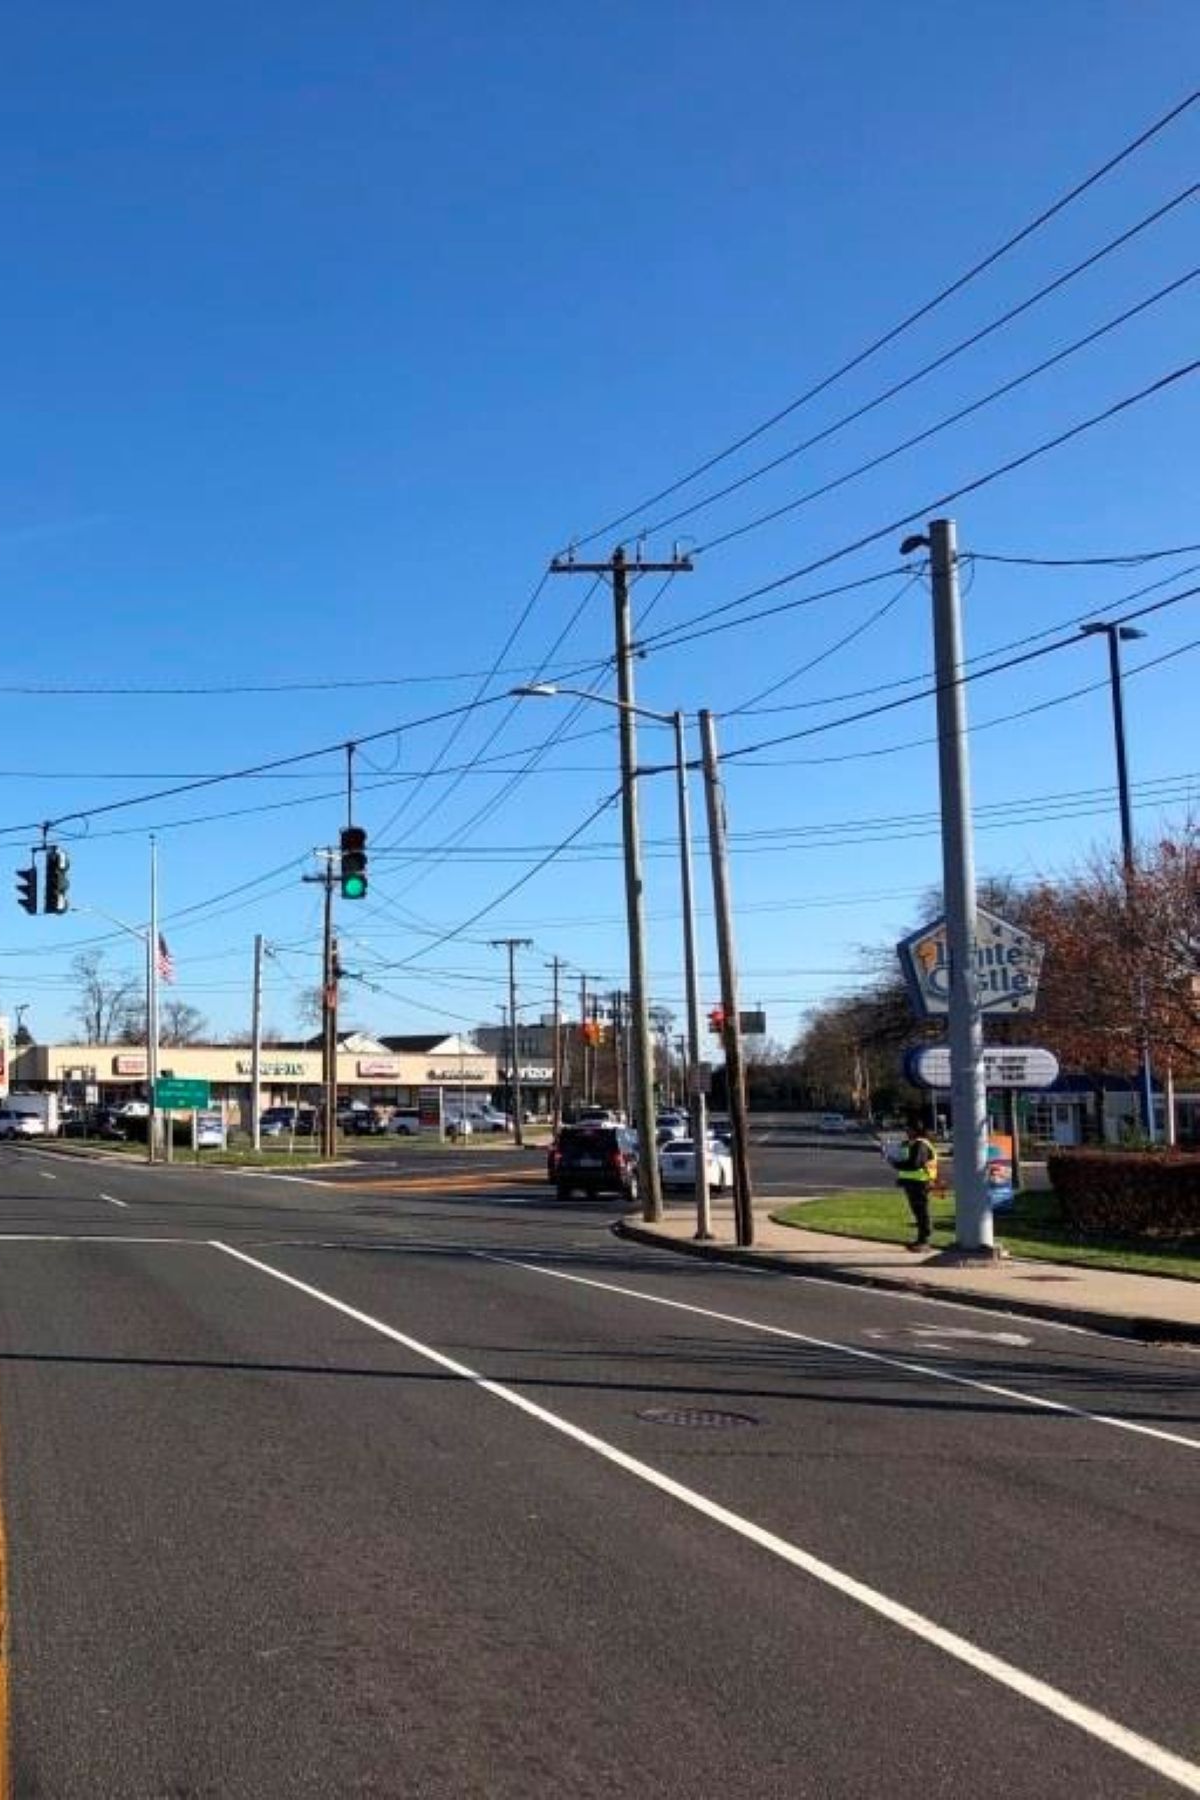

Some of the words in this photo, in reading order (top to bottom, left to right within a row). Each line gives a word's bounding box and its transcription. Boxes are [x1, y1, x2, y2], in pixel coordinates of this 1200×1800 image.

[936, 943, 1021, 967] ite
[927, 967, 1029, 993] Cstle
[503, 1064, 555, 1078] vrizon
